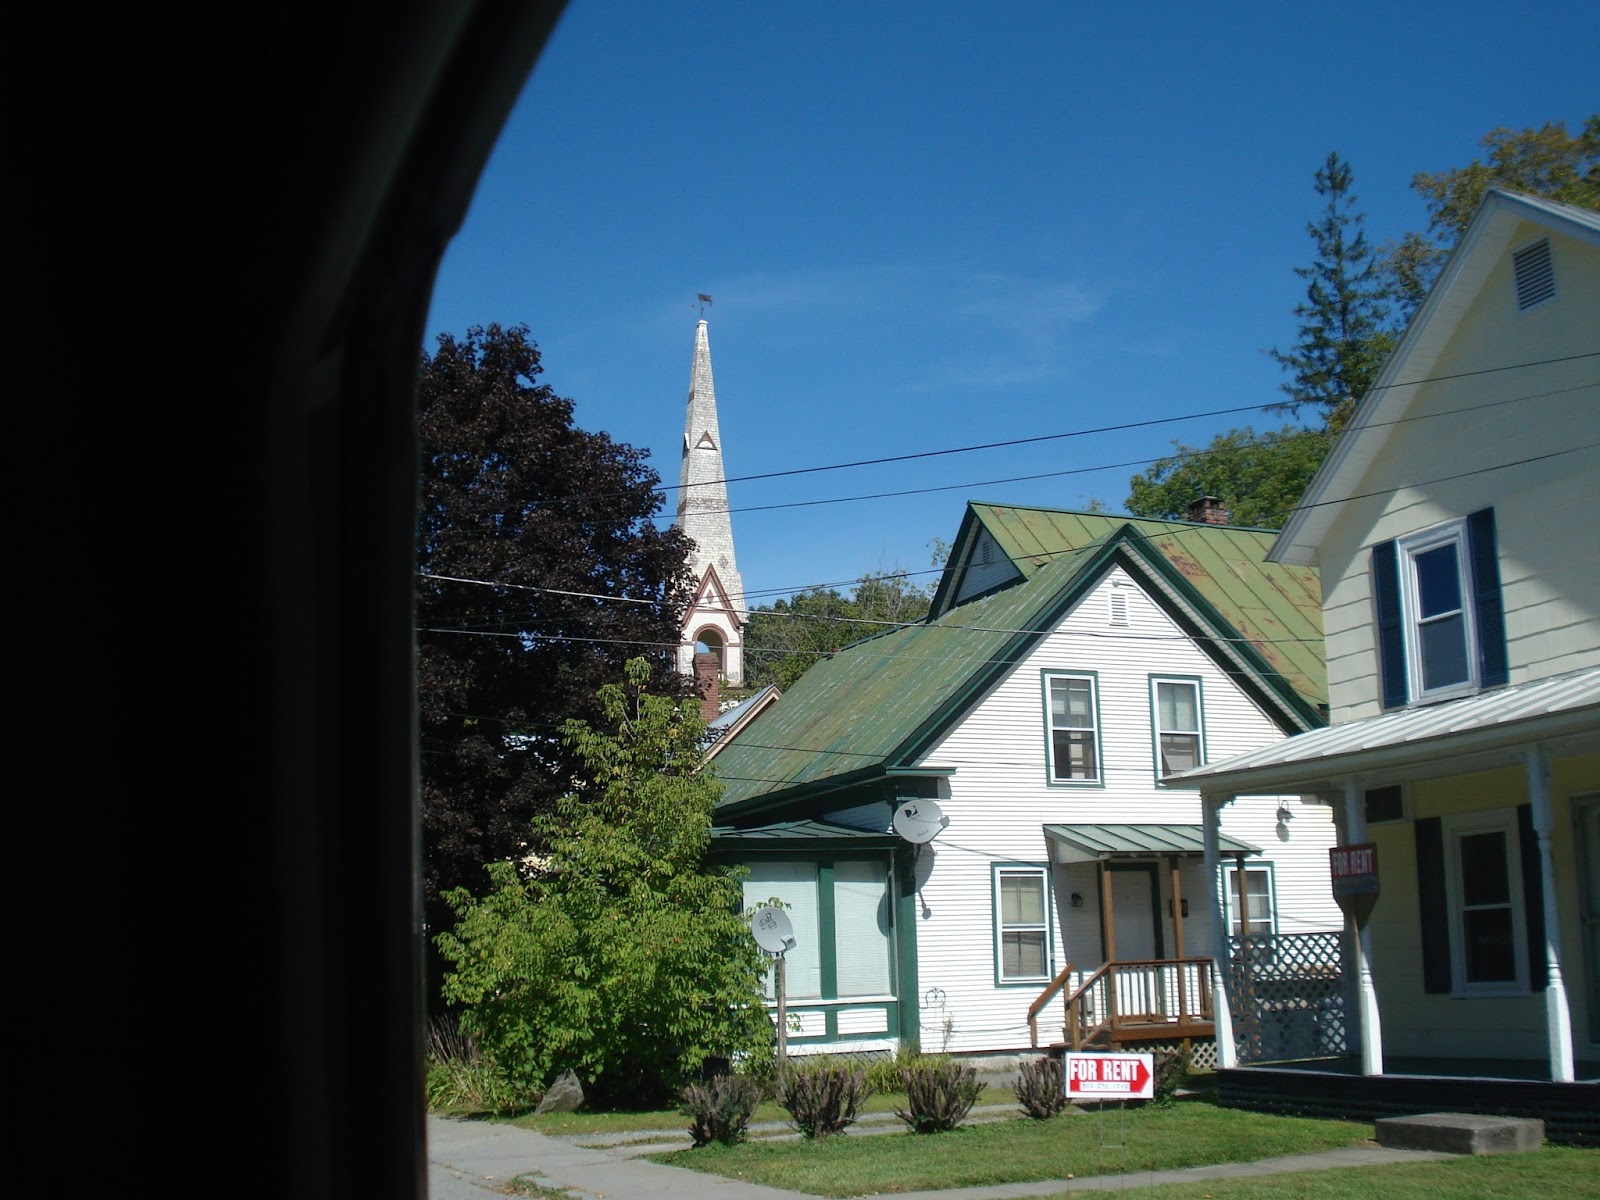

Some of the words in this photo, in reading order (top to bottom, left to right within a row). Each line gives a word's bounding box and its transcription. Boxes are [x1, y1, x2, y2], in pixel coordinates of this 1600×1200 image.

[1333, 852, 1349, 876] FOR
[1351, 849, 1373, 874] RENT
[1070, 1060, 1098, 1081] FOR
[1103, 1060, 1139, 1081] RENT
